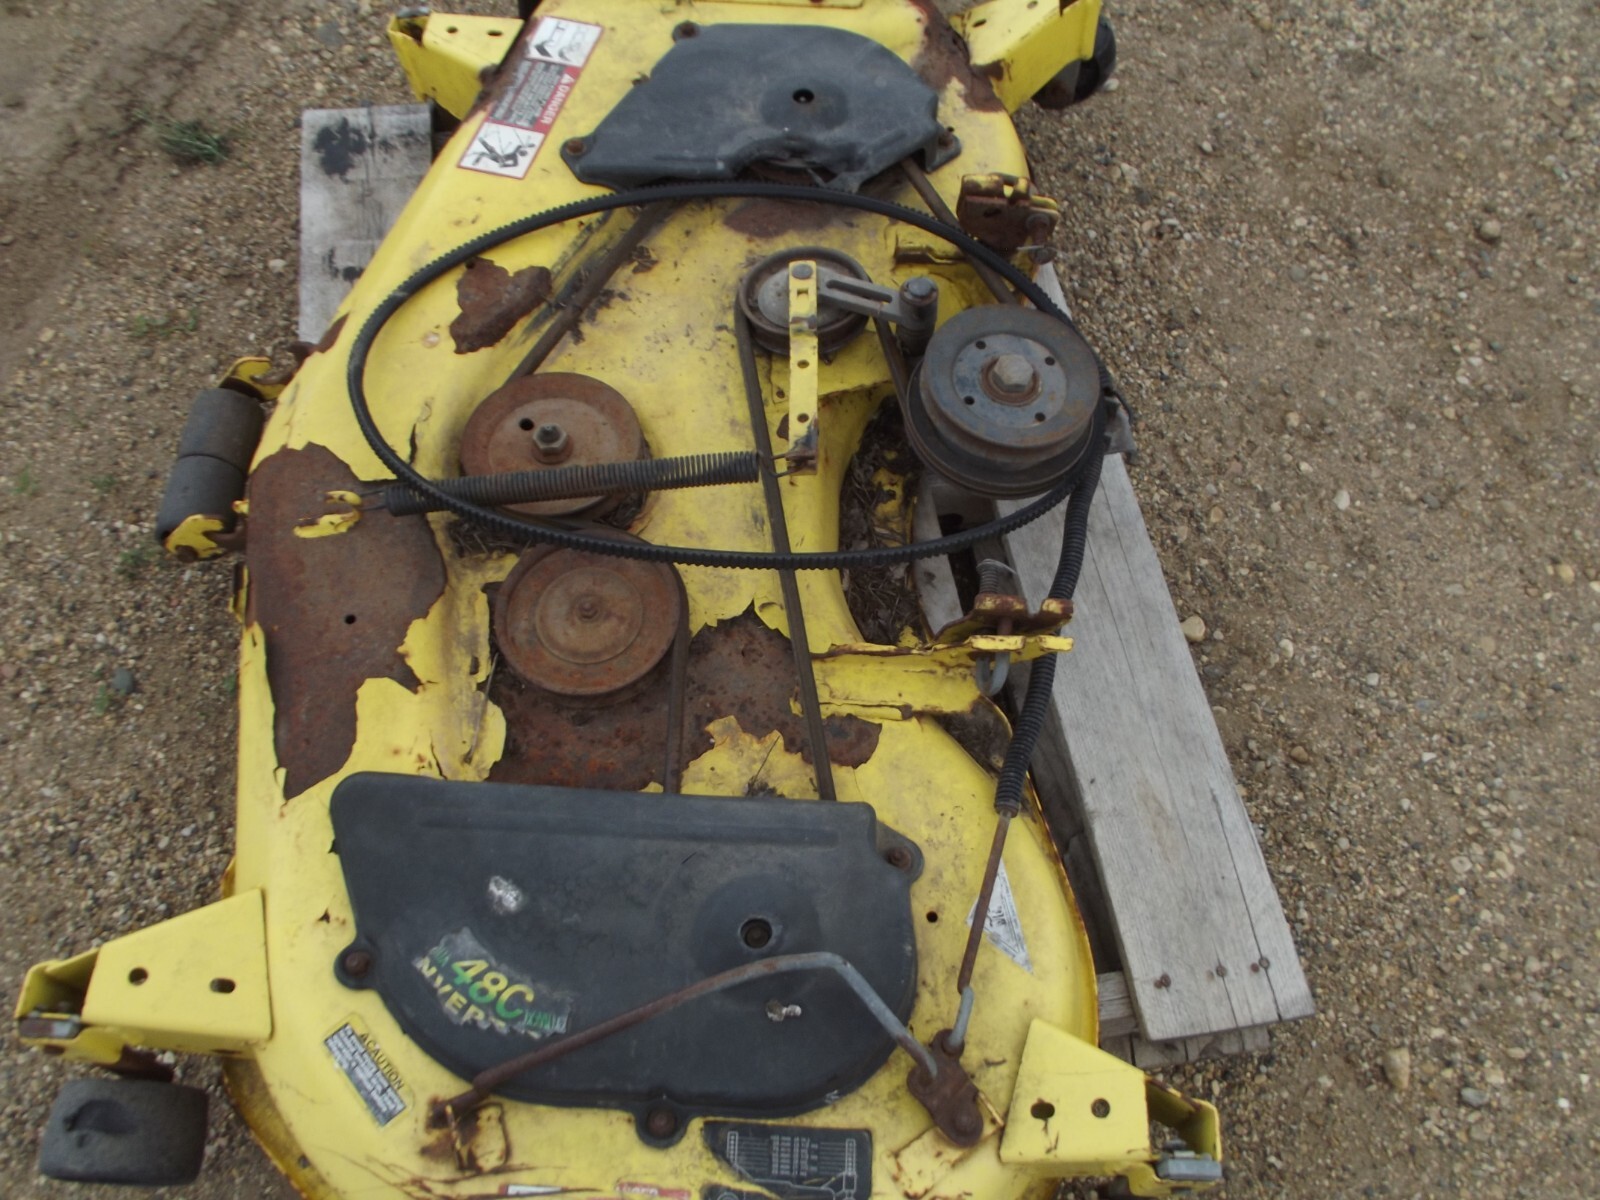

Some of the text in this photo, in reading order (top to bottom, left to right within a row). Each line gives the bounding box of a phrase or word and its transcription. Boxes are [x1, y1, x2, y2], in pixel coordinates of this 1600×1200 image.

[540, 84, 571, 125] DANGER
[452, 959, 535, 1019] 48C
[366, 1038, 405, 1091] CAUTION
